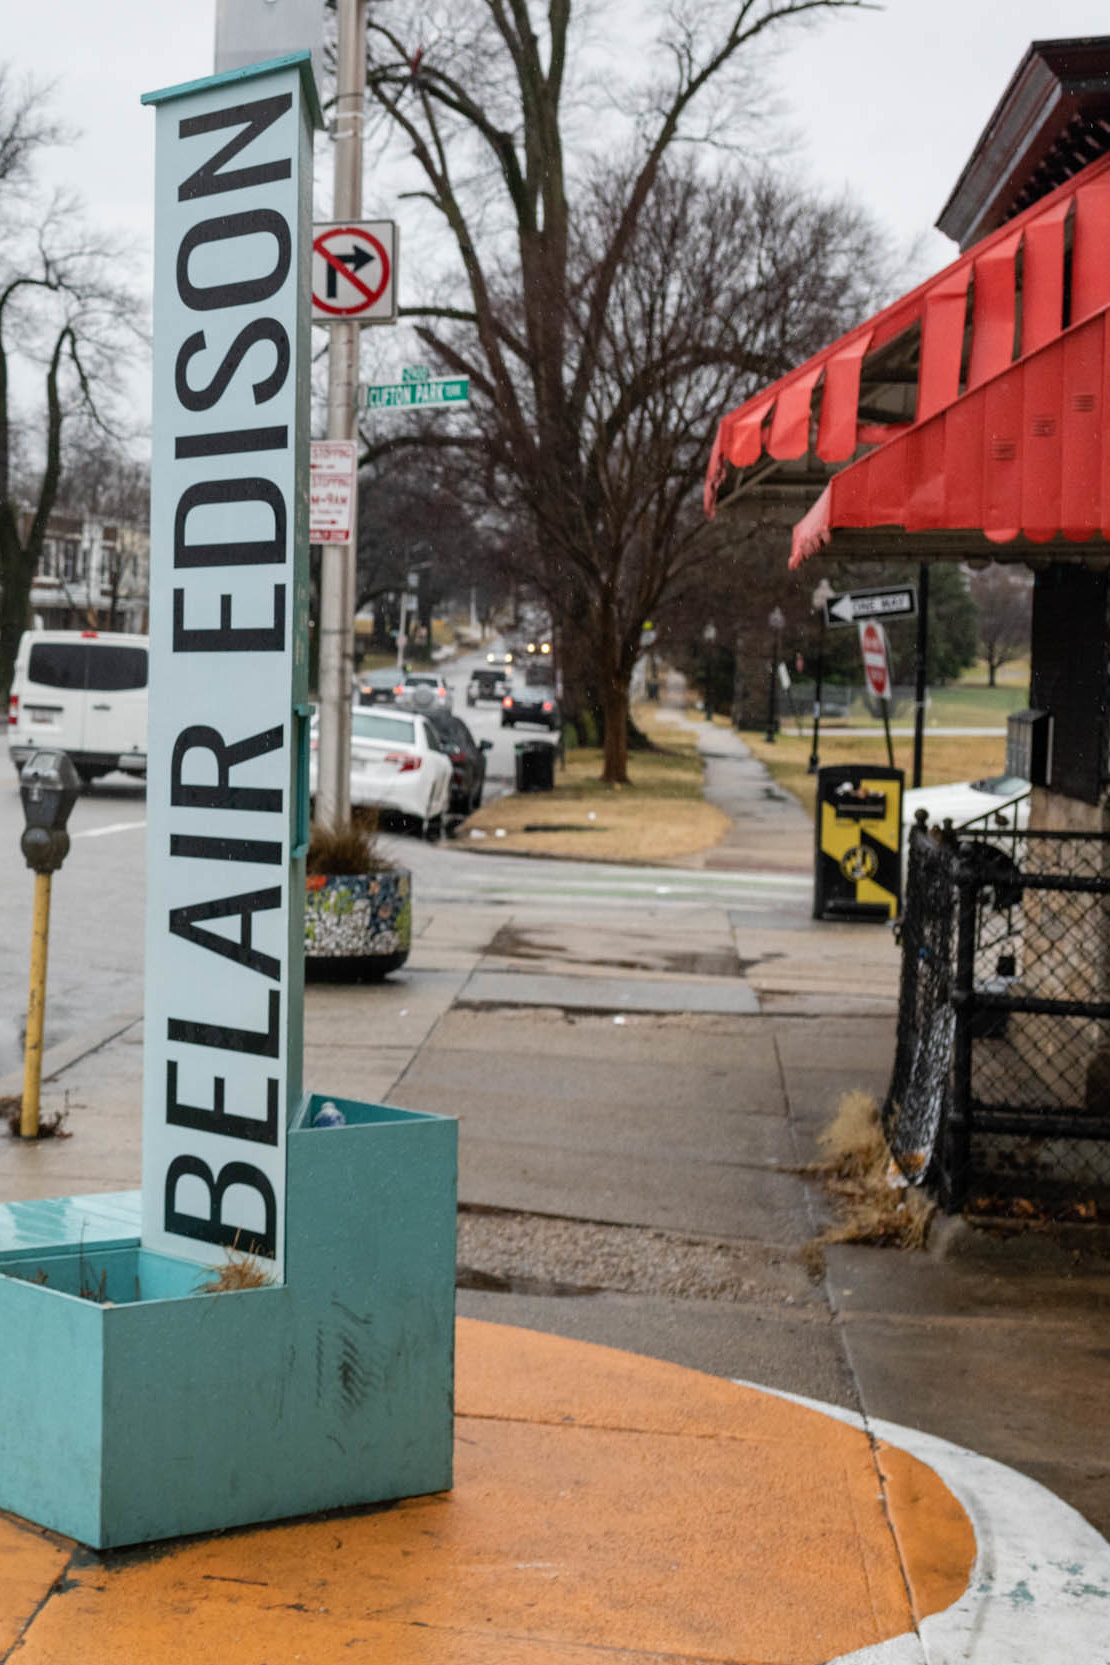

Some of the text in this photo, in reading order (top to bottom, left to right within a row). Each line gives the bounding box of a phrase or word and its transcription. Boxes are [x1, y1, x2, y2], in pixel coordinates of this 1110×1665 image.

[165, 91, 293, 1260] BELAIR EDISON
[369, 385, 411, 408] CLIFTON
[414, 383, 444, 403] PARK
